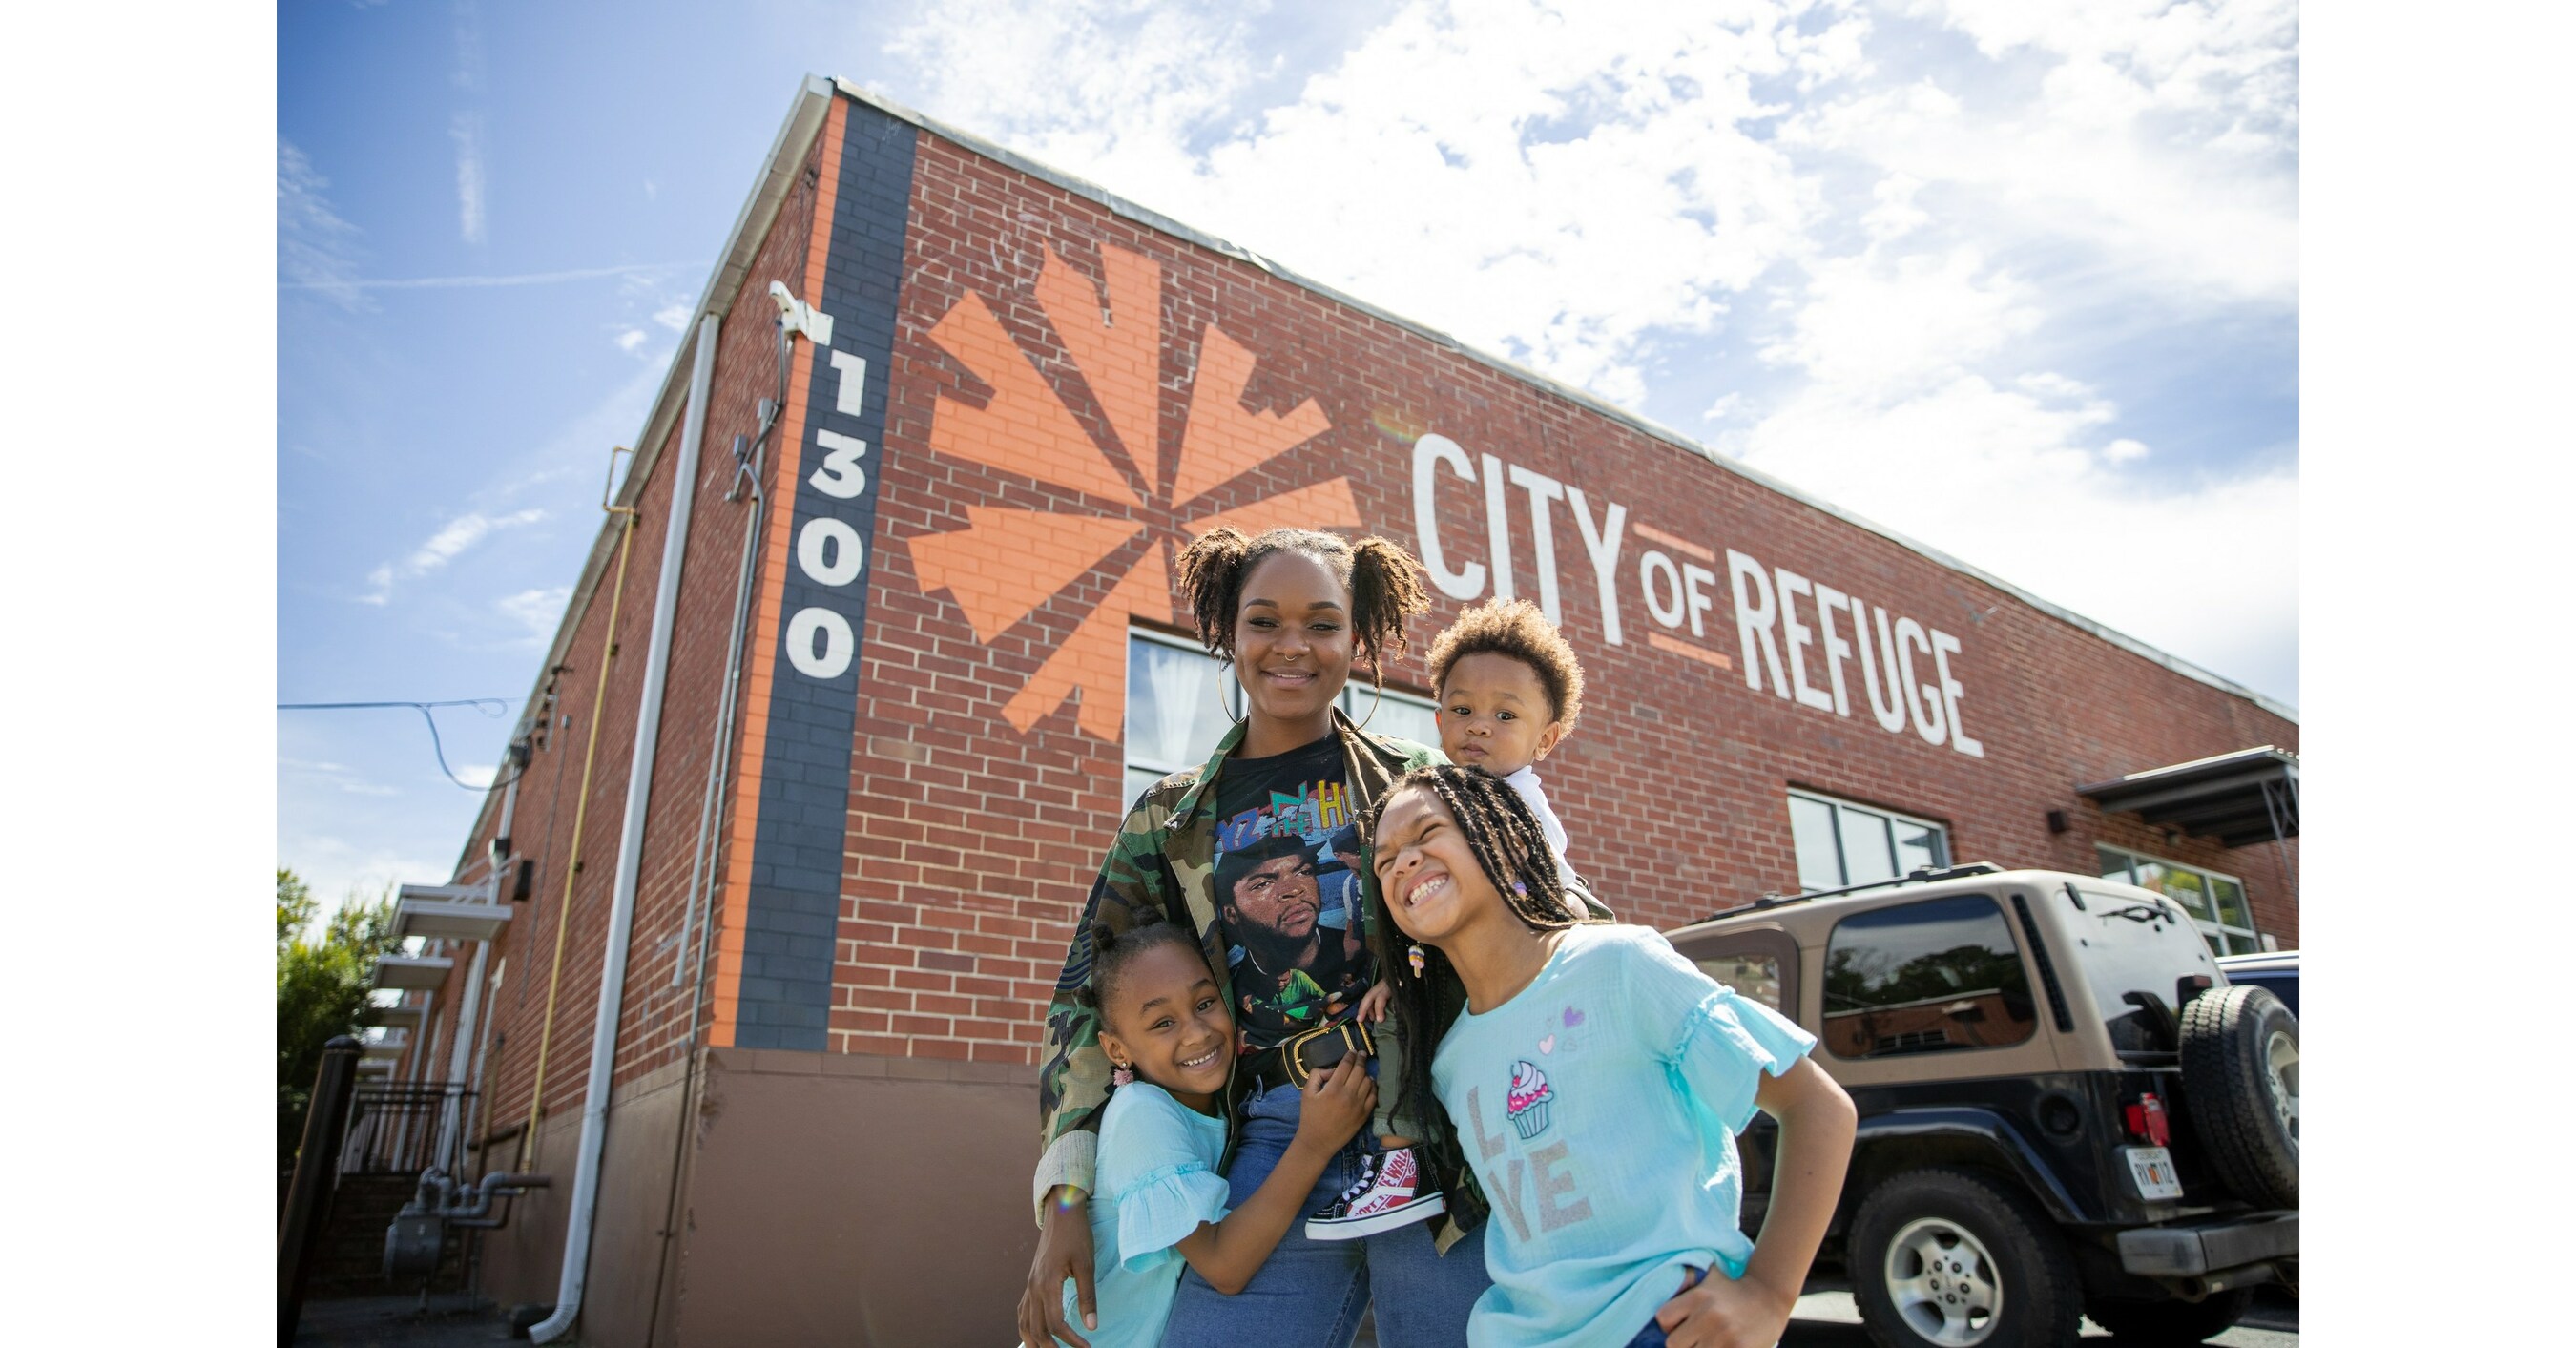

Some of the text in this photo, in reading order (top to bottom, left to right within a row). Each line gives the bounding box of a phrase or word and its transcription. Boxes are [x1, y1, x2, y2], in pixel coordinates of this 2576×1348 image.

[785, 349, 867, 679] 1300
[1412, 432, 1984, 758] CITY OF REFUGE
